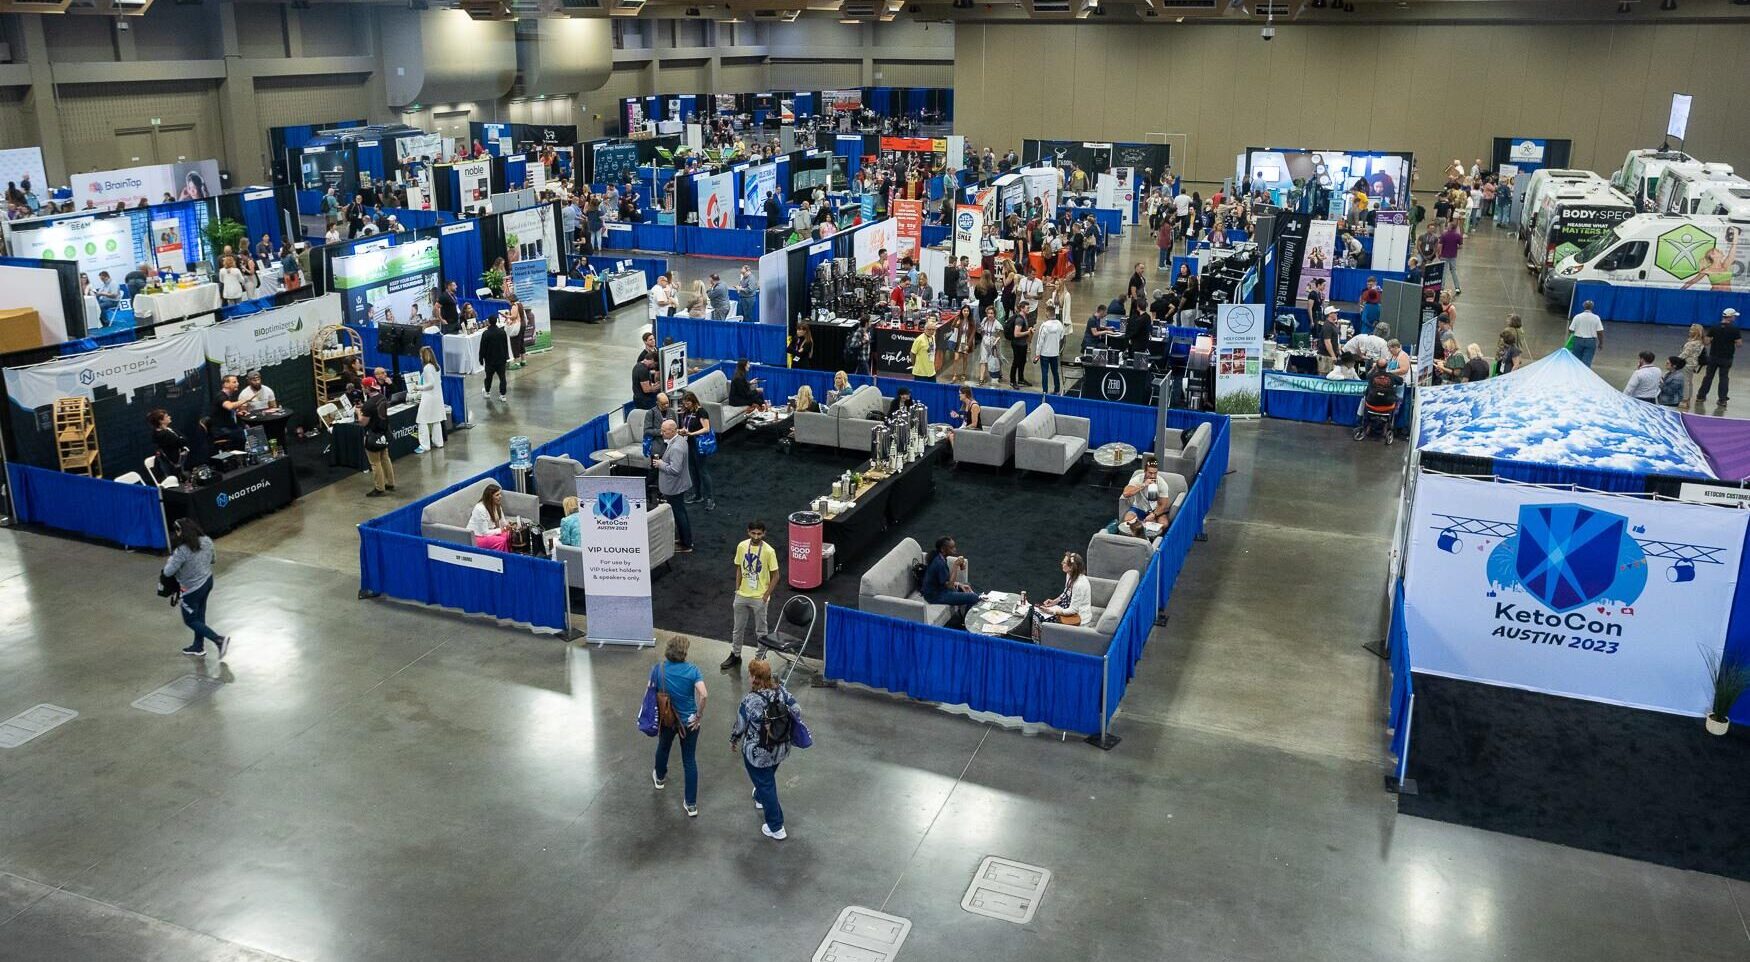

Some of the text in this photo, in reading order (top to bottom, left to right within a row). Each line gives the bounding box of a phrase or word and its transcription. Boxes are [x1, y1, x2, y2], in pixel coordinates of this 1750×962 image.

[464, 165, 484, 176] noble
[105, 178, 142, 191] BrainTap
[1276, 280, 1289, 306] THREA
[1292, 379, 1318, 391] HOLY
[1321, 381, 1347, 393] COW
[228, 479, 271, 501] NOOTOPIA
[1704, 490, 1726, 498] KETOCON
[790, 545, 811, 554] GOOD
[792, 552, 807, 560] IDEA
[1494, 601, 1623, 637] KetoCon
[1491, 625, 1620, 654] AUSTIN 2023
